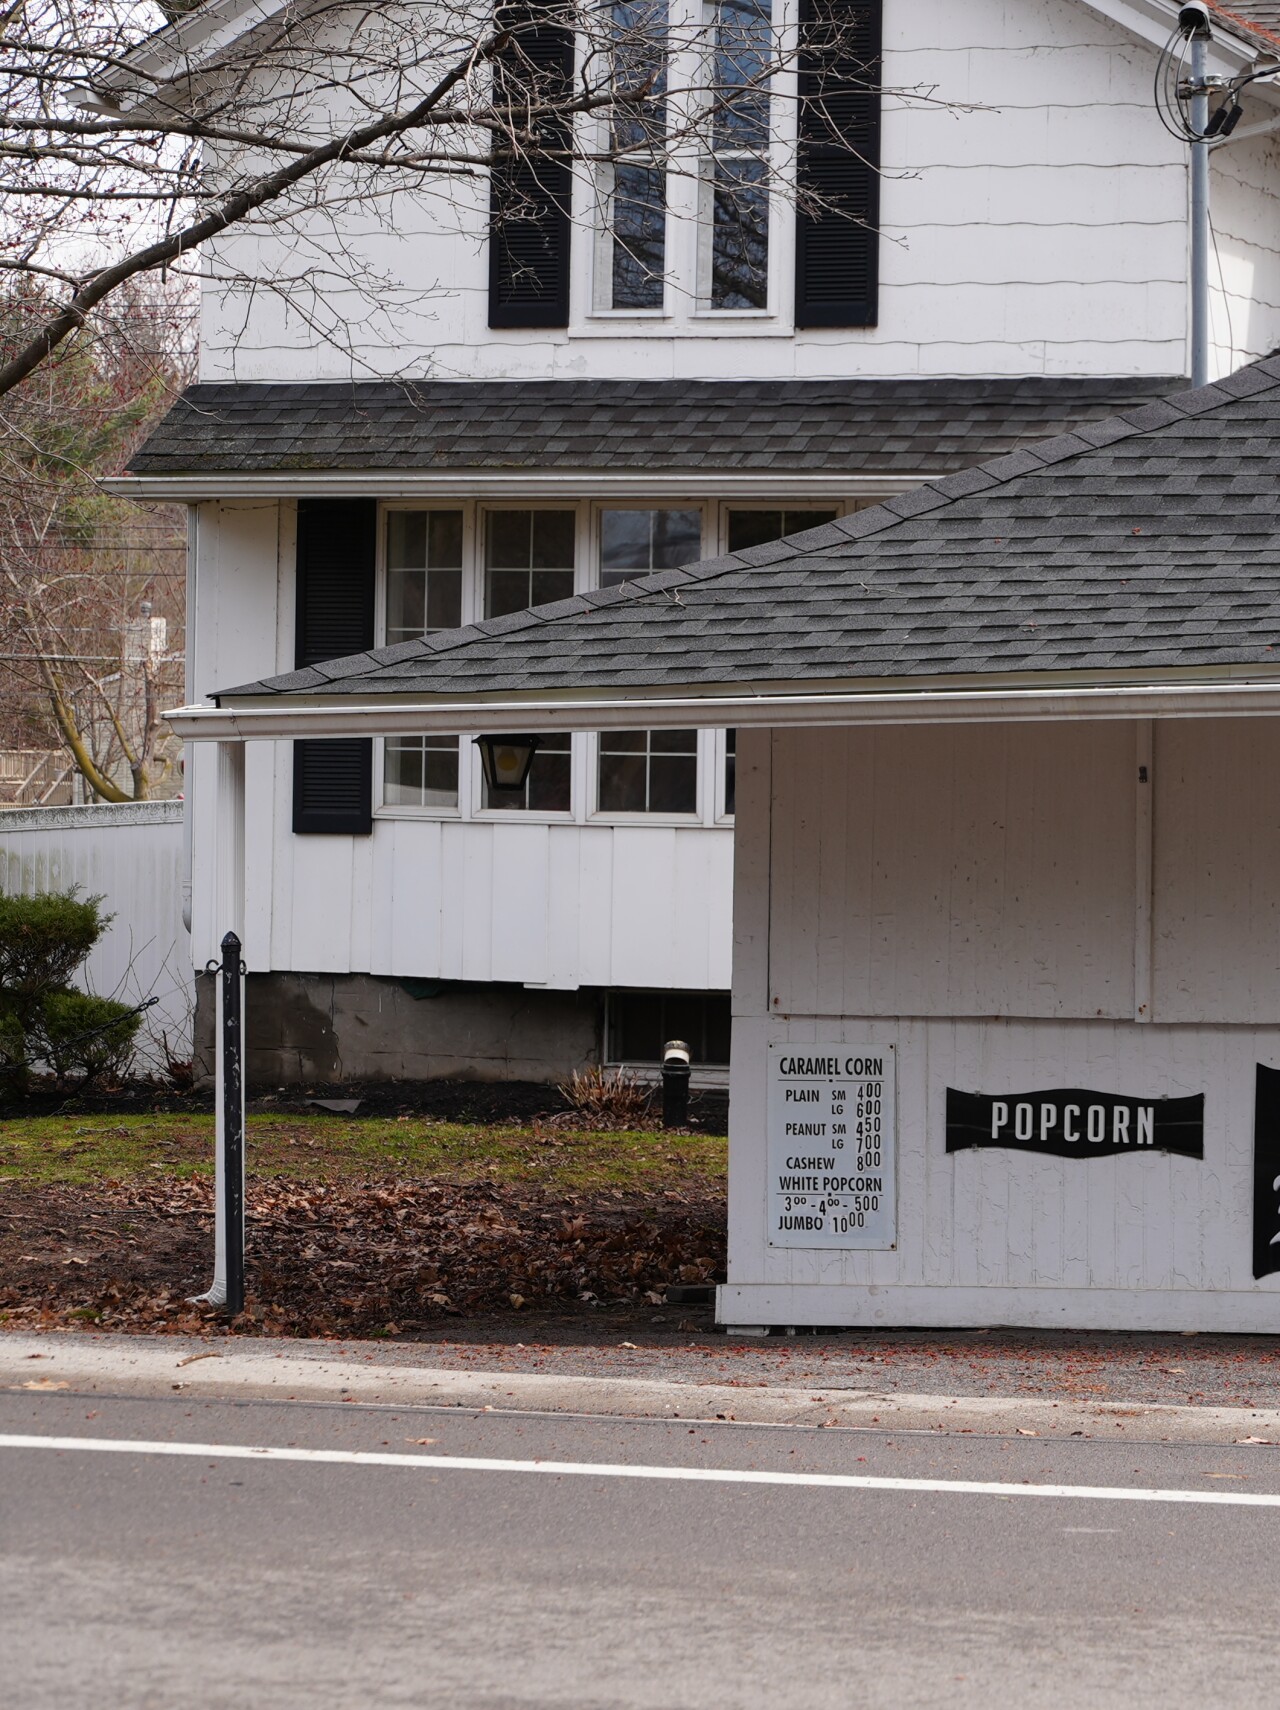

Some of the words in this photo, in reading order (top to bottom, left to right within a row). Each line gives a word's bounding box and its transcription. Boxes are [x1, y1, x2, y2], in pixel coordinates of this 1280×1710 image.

[779, 1057, 841, 1075] CARAMEL
[845, 1058, 883, 1076] CORN
[786, 1090, 819, 1102] PLAIN
[832, 1090, 846, 1101] SM
[832, 1104, 843, 1115] LG
[786, 1123, 826, 1135] PEANUT
[832, 1124, 846, 1134] SM
[992, 1101, 1154, 1145] POPCORN
[832, 1139, 844, 1149] LG
[786, 1157, 835, 1169] CASHEW
[779, 1176, 818, 1191] WHITE
[823, 1177, 882, 1192] POPCORN
[778, 1216, 823, 1230] JUMBO
